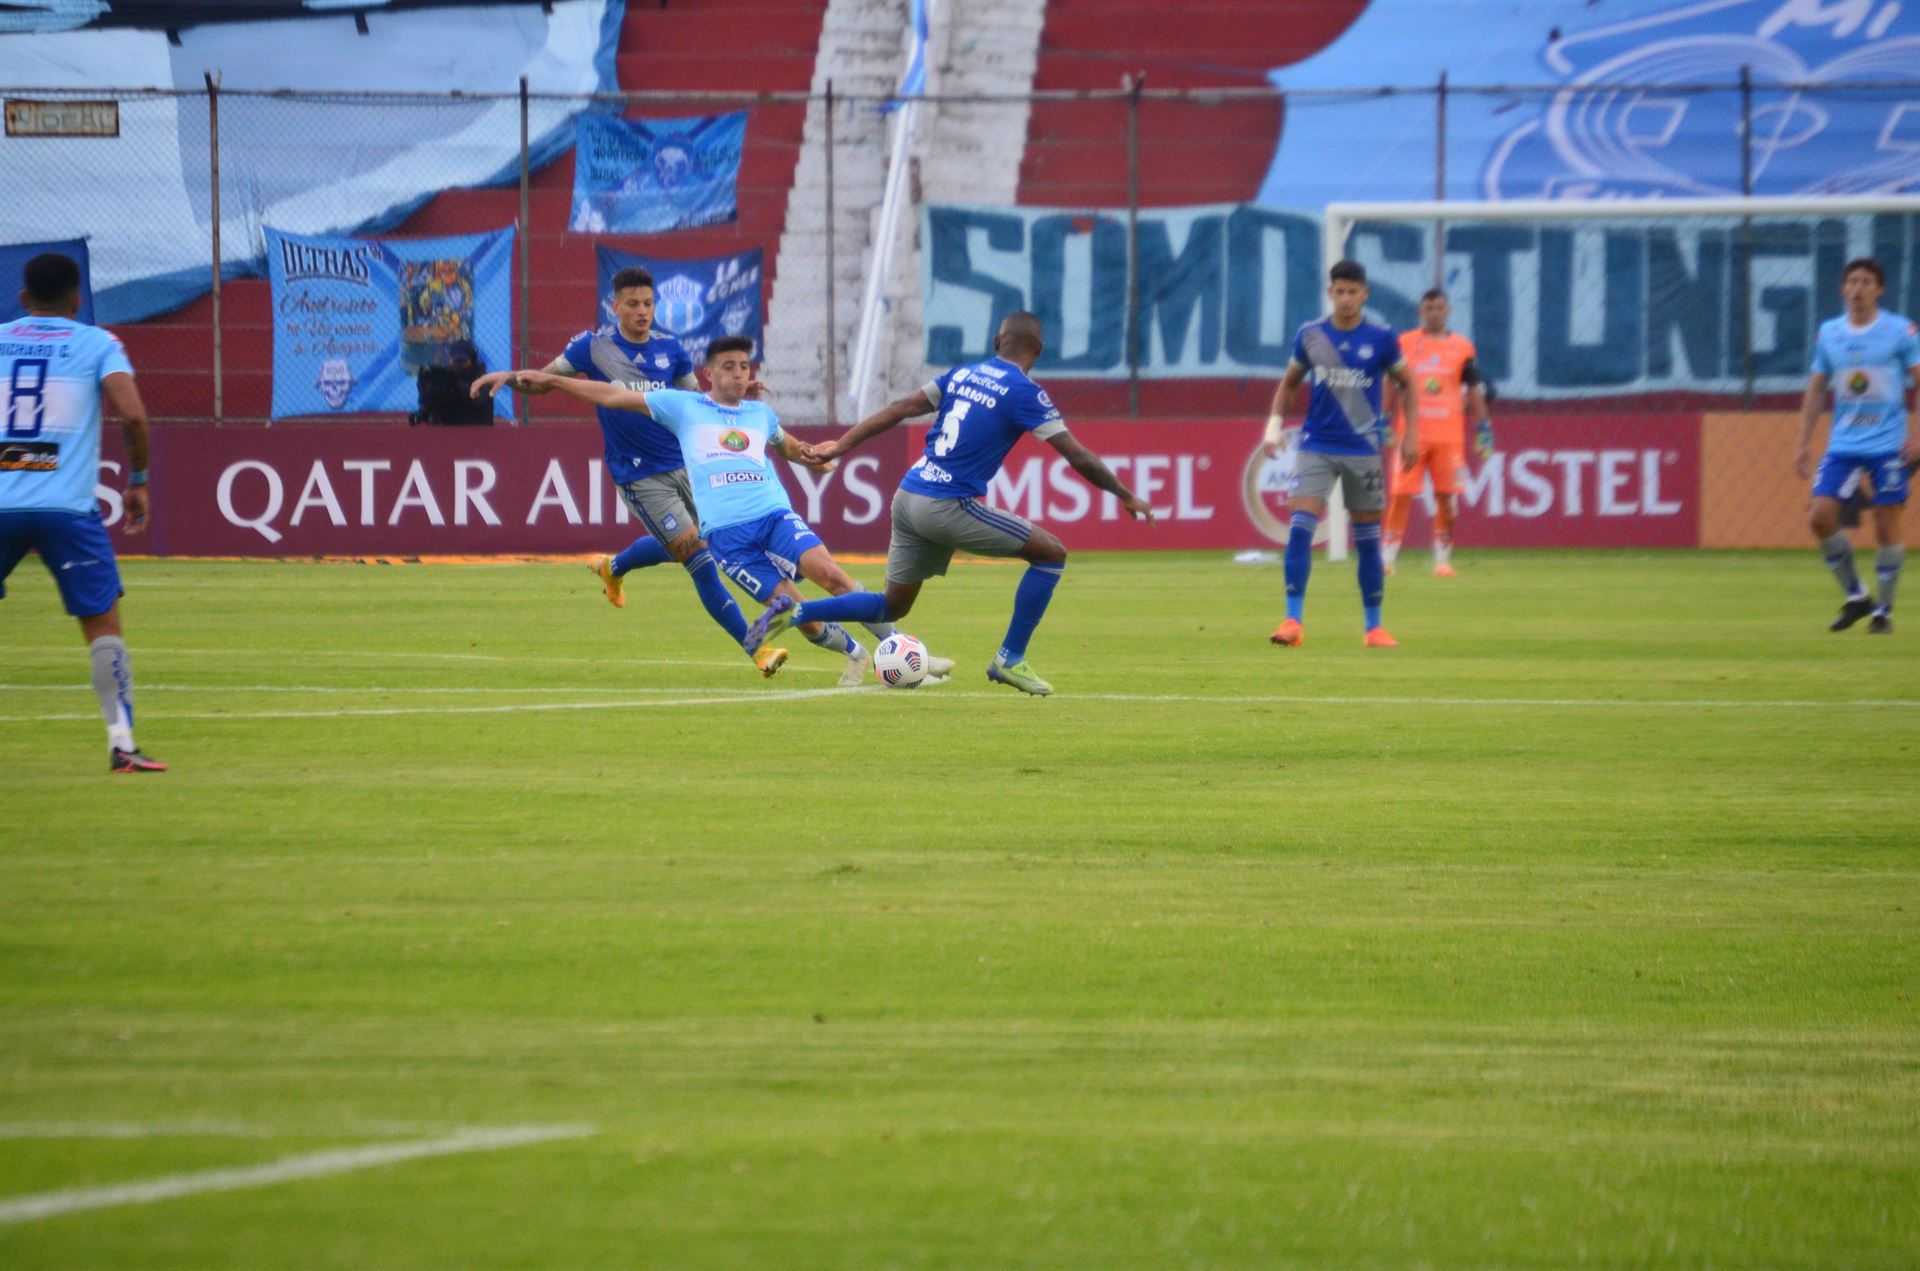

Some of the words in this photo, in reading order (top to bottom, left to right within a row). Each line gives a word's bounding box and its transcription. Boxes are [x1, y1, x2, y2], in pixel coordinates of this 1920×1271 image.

[280, 238, 369, 276] ULTRAS
[8, 358, 48, 438] 8
[934, 398, 972, 457] 5
[216, 458, 502, 544] QATAR
[526, 457, 883, 526] AIYS
[986, 455, 1215, 522] MSTEL
